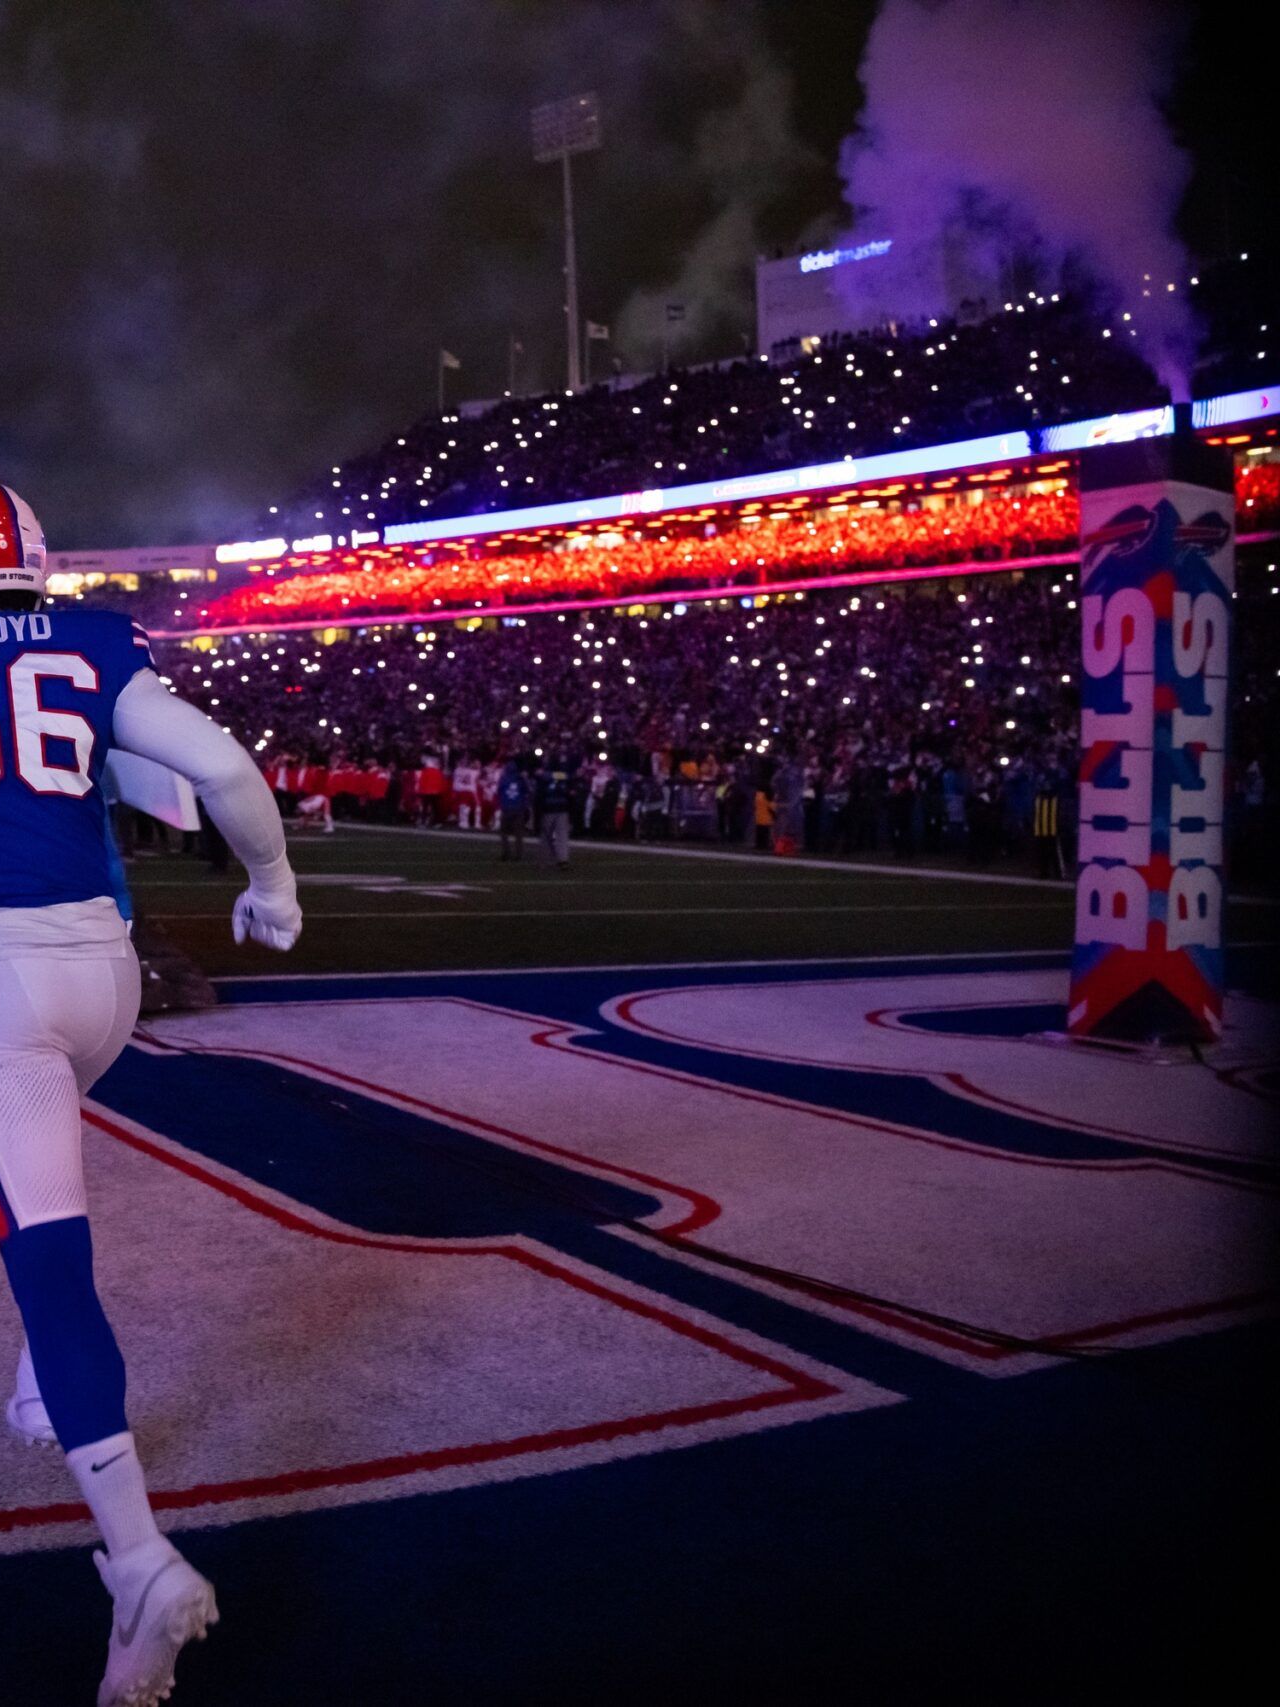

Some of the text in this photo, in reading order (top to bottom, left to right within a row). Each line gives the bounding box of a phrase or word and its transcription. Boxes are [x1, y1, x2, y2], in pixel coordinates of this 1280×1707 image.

[9, 573, 34, 582] STORIES
[1077, 588, 1154, 949] BILLS
[1169, 592, 1229, 950] BILLS
